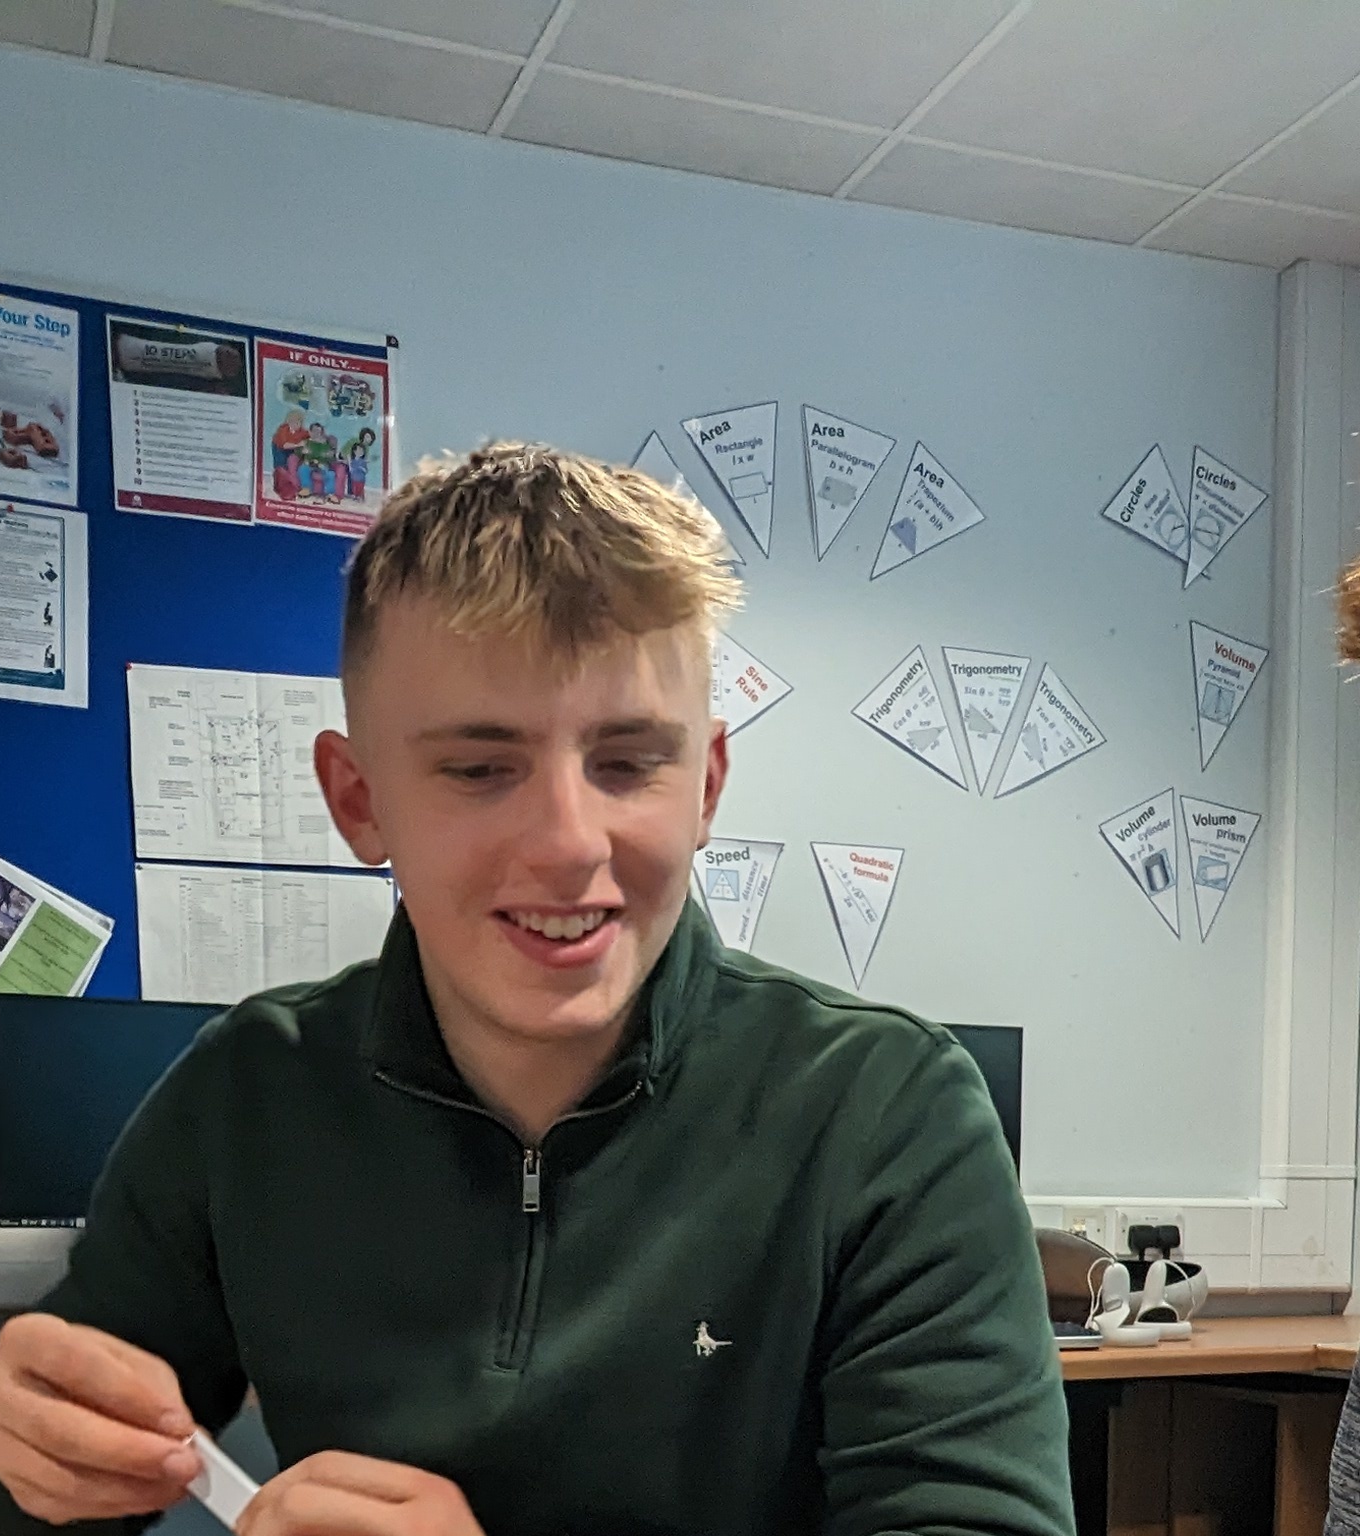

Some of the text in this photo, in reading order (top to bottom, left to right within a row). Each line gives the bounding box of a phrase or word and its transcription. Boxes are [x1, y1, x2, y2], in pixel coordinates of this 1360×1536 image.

[33, 312, 71, 338] Step
[288, 350, 302, 362] IF
[698, 419, 732, 445] Area
[811, 421, 845, 439] Area
[714, 436, 764, 454] Rectangle
[810, 439, 876, 472] Parallelogram
[912, 462, 946, 489] Area
[1195, 465, 1238, 492] Circles
[917, 478, 955, 524] Trapezium
[1119, 477, 1148, 524] Circles
[1214, 640, 1257, 673] Volume
[744, 665, 769, 692] Sine
[951, 664, 1023, 677] Trigonometry
[735, 676, 760, 704] Rule
[868, 658, 925, 724] Trigonometry
[1040, 680, 1096, 745] Trigonometry
[1115, 805, 1156, 843] Volume
[1137, 817, 1171, 841] cylinder
[1192, 813, 1237, 827] Volume
[1216, 827, 1246, 845] prism
[705, 846, 751, 865] Speed
[848, 852, 895, 872] Quadratic
[853, 866, 889, 883] formula
